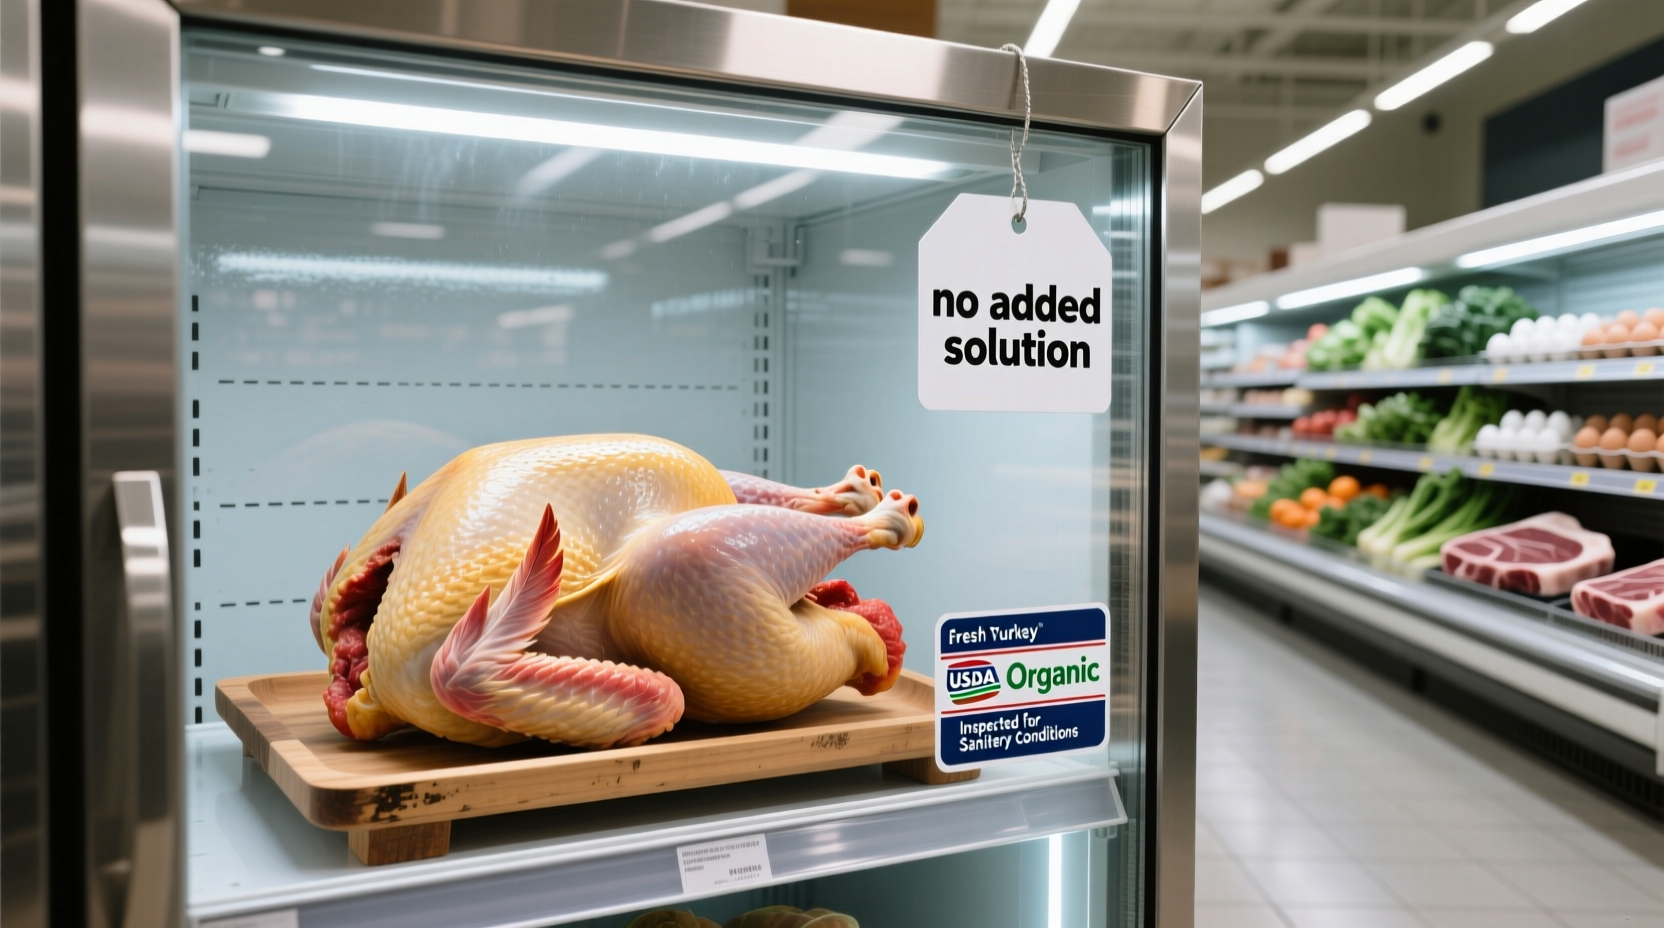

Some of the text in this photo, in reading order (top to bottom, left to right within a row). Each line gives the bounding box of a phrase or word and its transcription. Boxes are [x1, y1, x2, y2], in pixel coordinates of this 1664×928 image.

[933, 283, 1101, 324] no added
[944, 327, 1090, 368] solution
[949, 626, 986, 645] Fresh
[950, 656, 1100, 694] USDA Organic
[1015, 725, 1079, 744] Conditions
